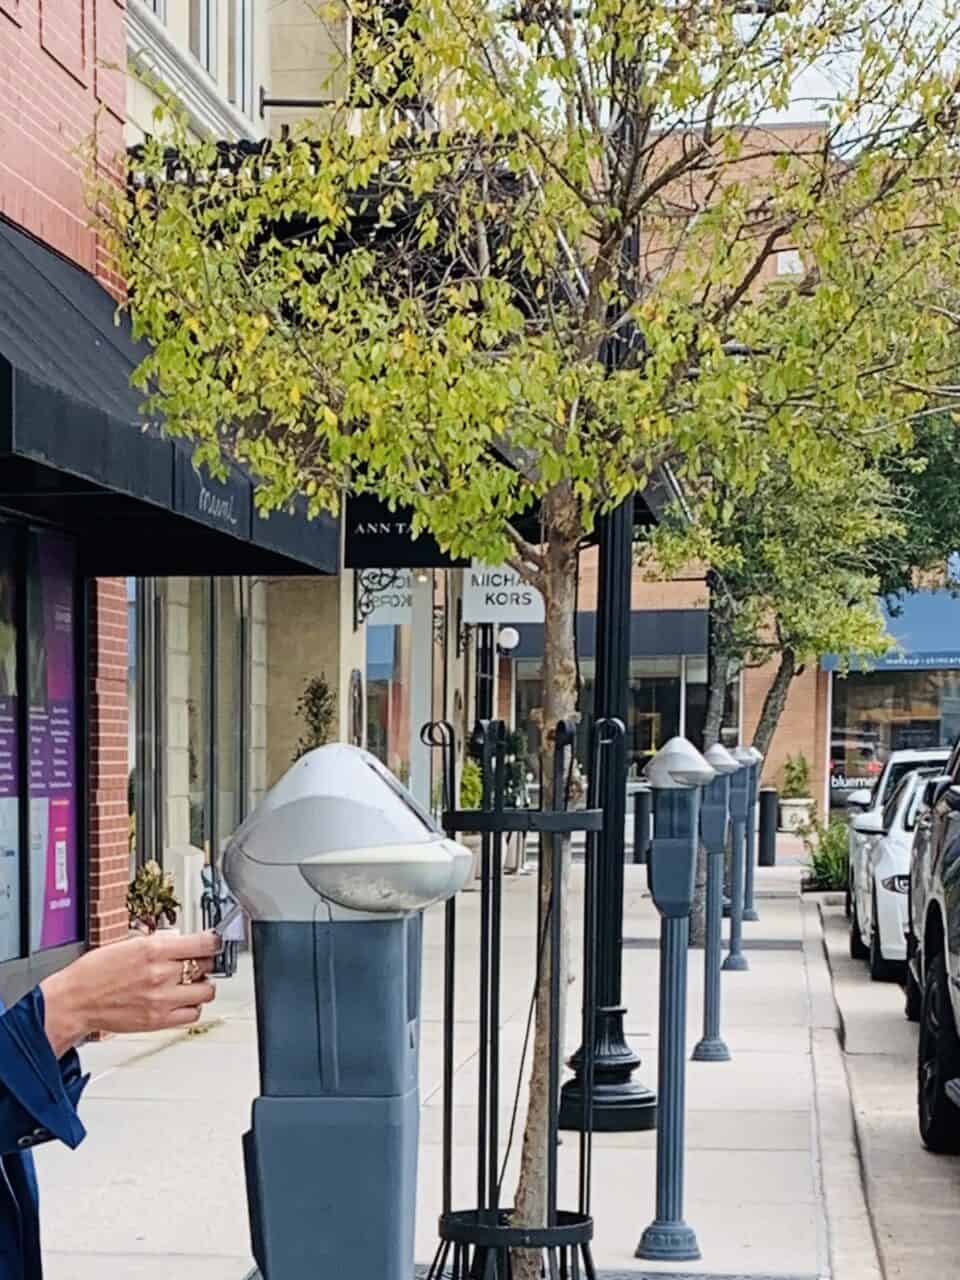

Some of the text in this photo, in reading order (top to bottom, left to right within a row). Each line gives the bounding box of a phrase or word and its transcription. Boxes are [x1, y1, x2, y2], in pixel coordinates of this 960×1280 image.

[354, 522, 391, 535] ANN
[471, 573, 526, 588] MICH
[485, 592, 533, 606] KORS
